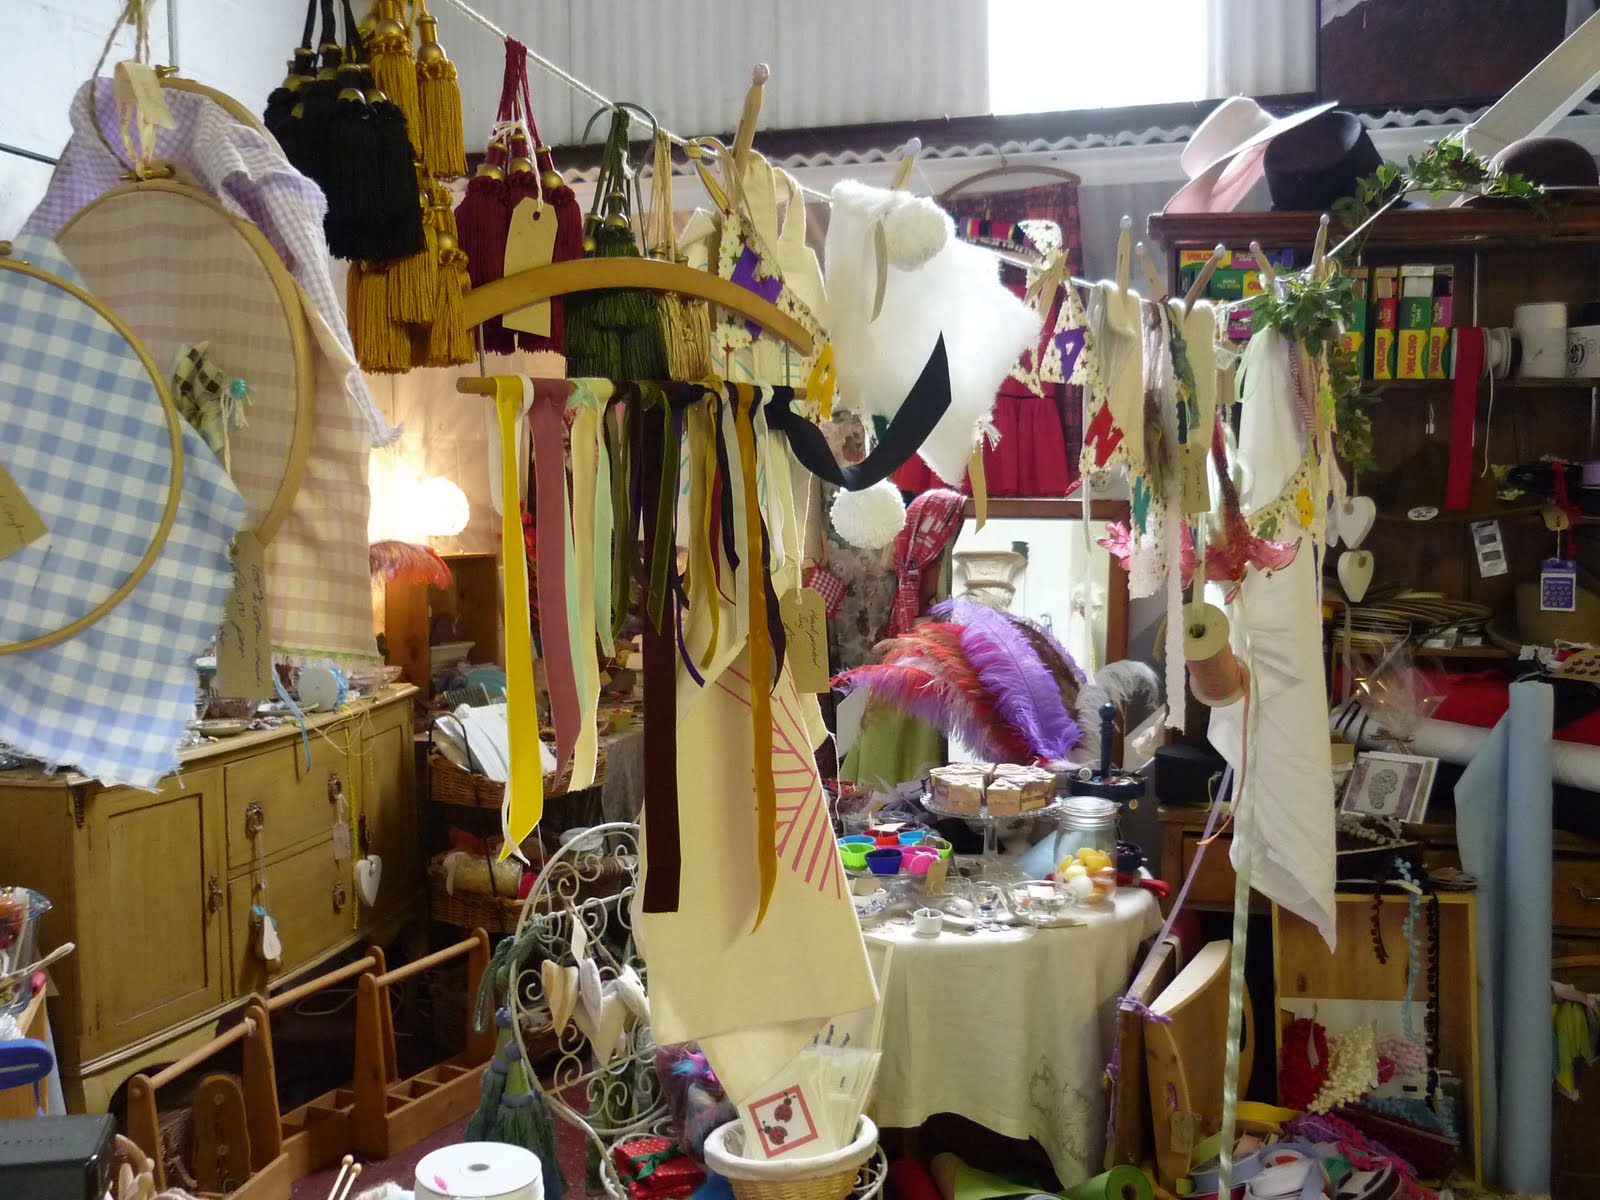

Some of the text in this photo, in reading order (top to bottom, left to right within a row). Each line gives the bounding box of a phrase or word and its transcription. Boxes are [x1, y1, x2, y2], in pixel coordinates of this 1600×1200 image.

[1376, 336, 1386, 374] VELCRO
[1407, 334, 1417, 375] VELCRO
[1431, 335, 1441, 374] VELCRO
